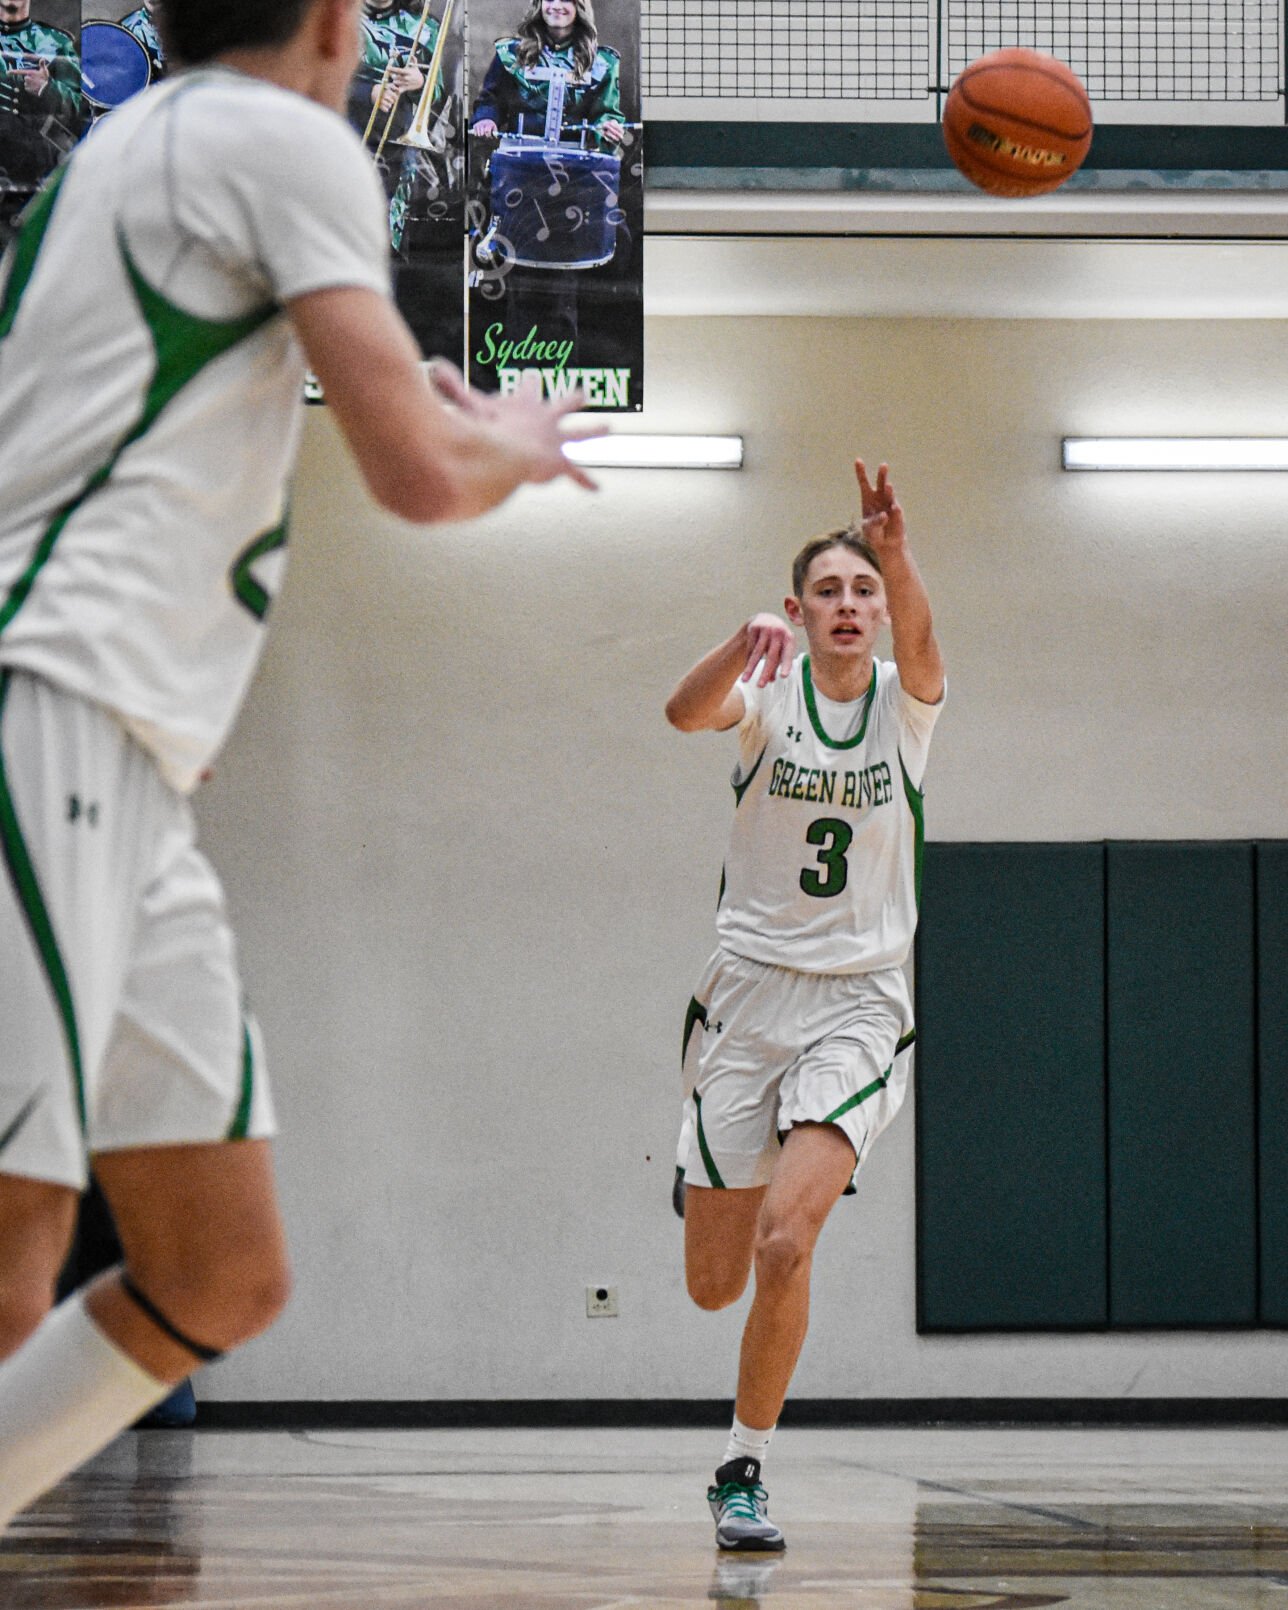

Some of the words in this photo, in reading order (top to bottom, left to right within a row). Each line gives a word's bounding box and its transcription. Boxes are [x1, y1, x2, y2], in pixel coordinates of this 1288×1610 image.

[476, 322, 574, 370] Sydney
[768, 757, 837, 805] GREEN
[841, 760, 892, 809] RIVER
[799, 817, 853, 898] 3
